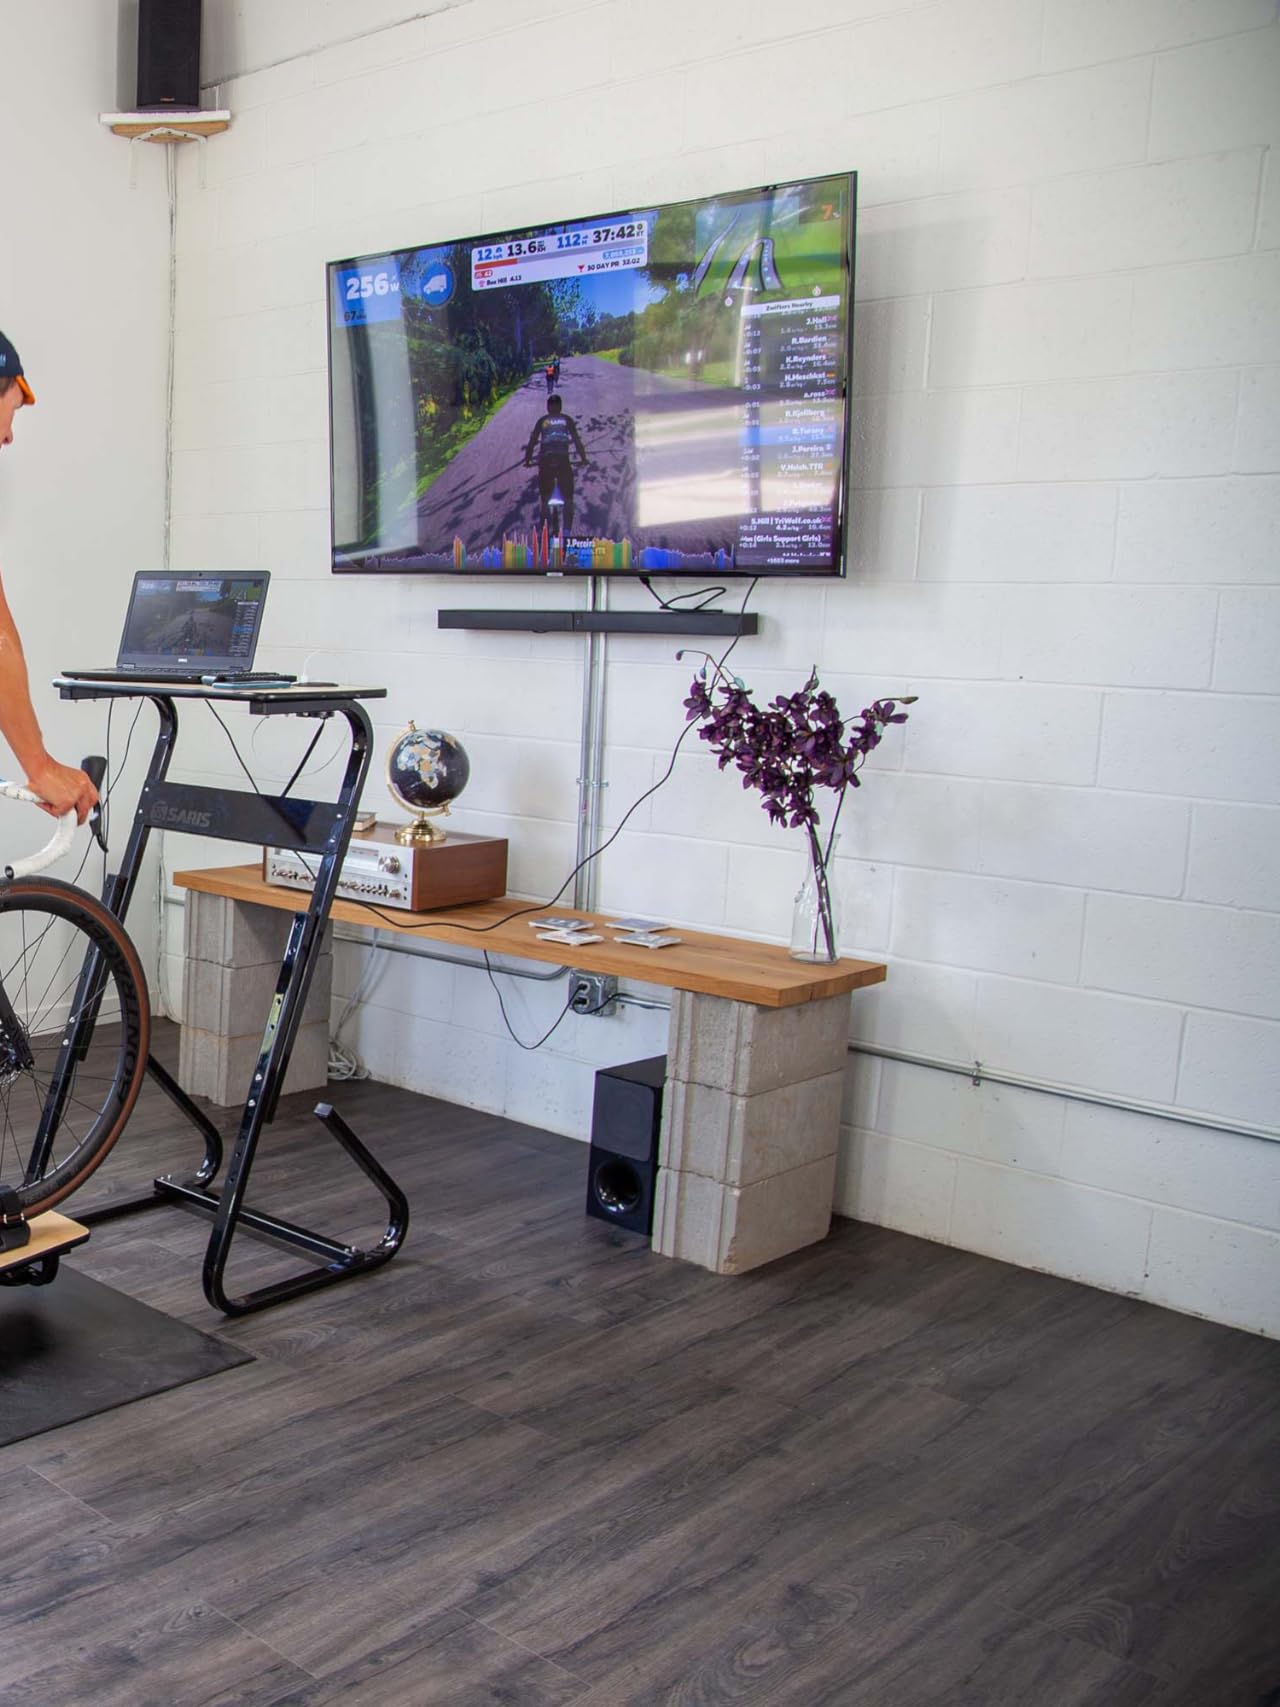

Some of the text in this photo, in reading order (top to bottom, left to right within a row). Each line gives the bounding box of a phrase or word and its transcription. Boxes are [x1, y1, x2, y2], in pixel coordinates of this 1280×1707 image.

[507, 241, 537, 258] 13.6
[557, 233, 581, 249] 112
[593, 225, 636, 243] 37:42
[596, 262, 609, 271] DAY
[610, 260, 620, 269] PR
[346, 272, 389, 300] 256
[773, 535, 800, 543] Support
[801, 534, 822, 542] Girls)
[167, 807, 211, 827] SARIS
